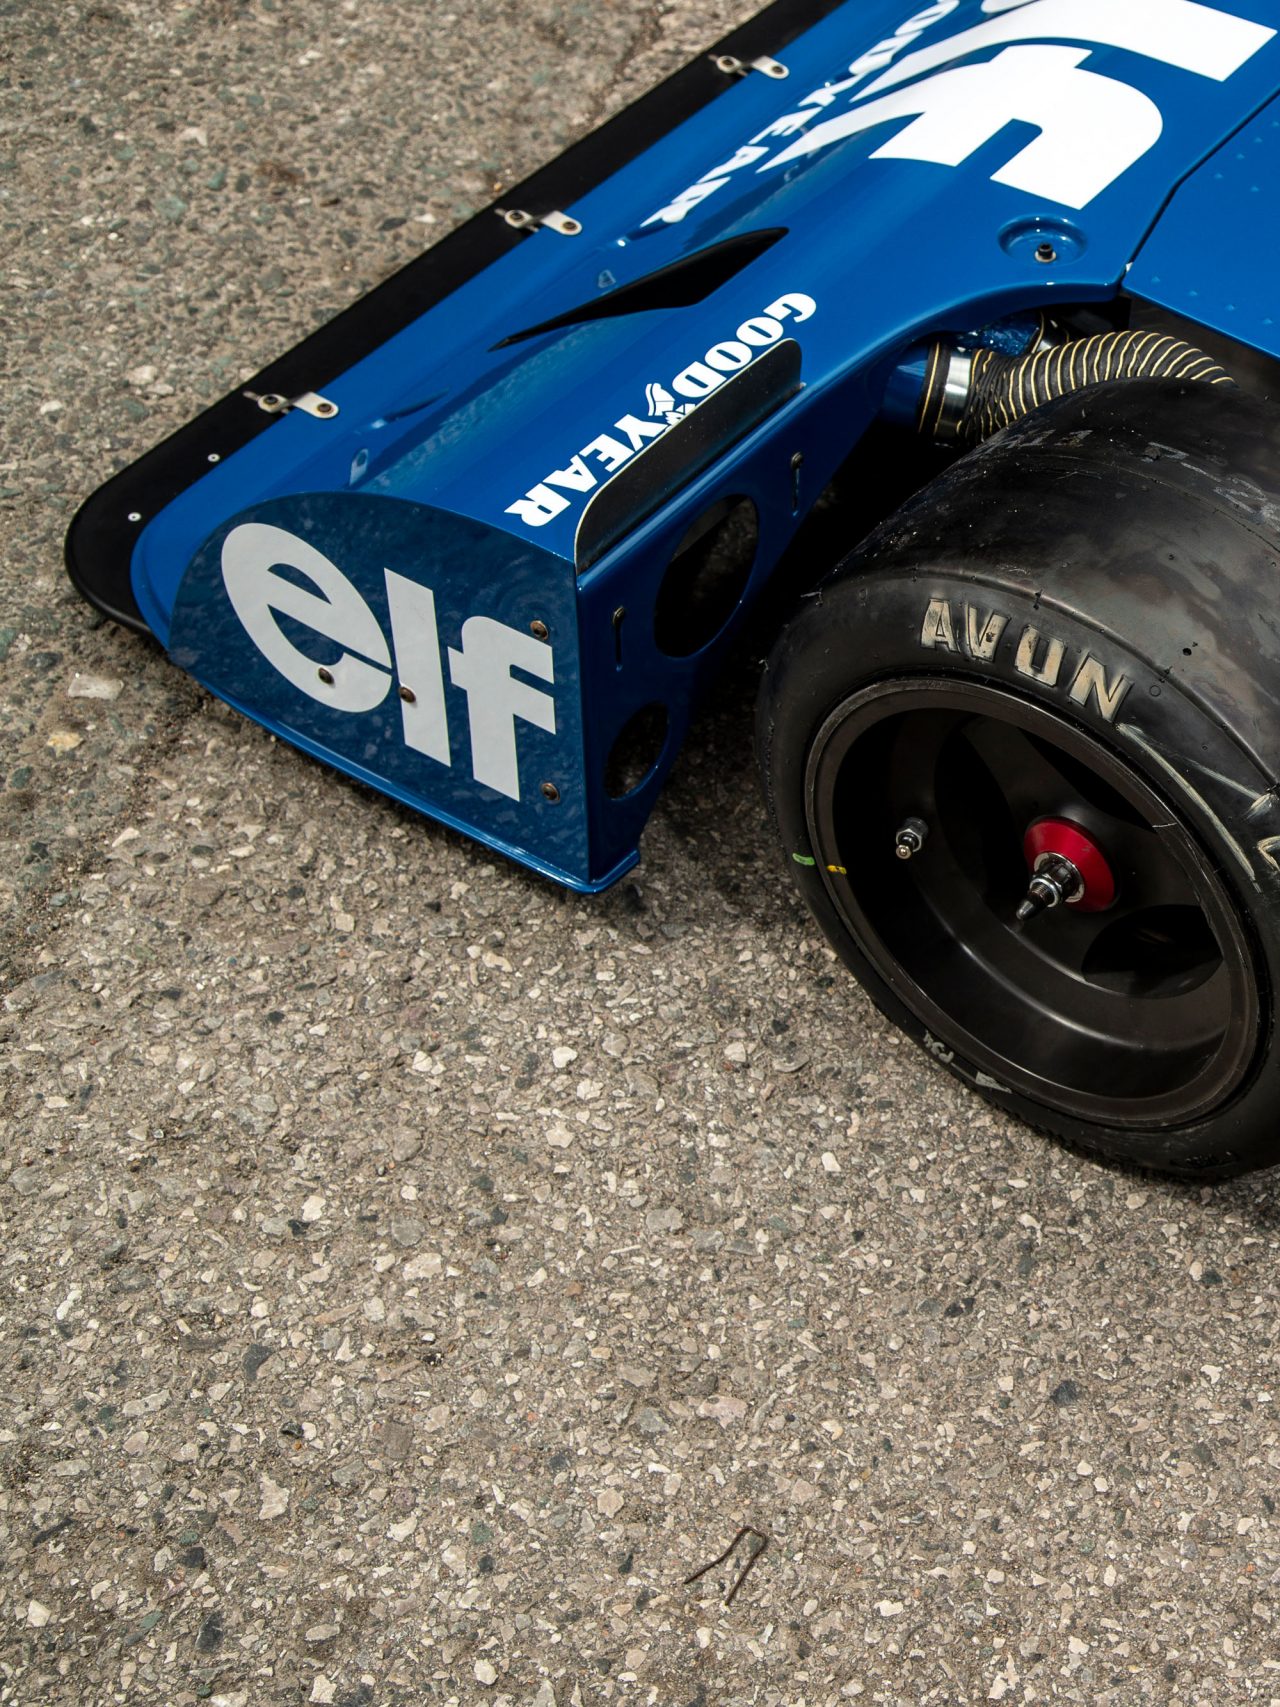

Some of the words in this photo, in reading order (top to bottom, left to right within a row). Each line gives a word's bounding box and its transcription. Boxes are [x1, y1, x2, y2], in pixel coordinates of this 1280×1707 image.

[504, 292, 817, 527] GOODYEAR
[221, 522, 556, 802] elf
[920, 597, 1136, 724] AVON
